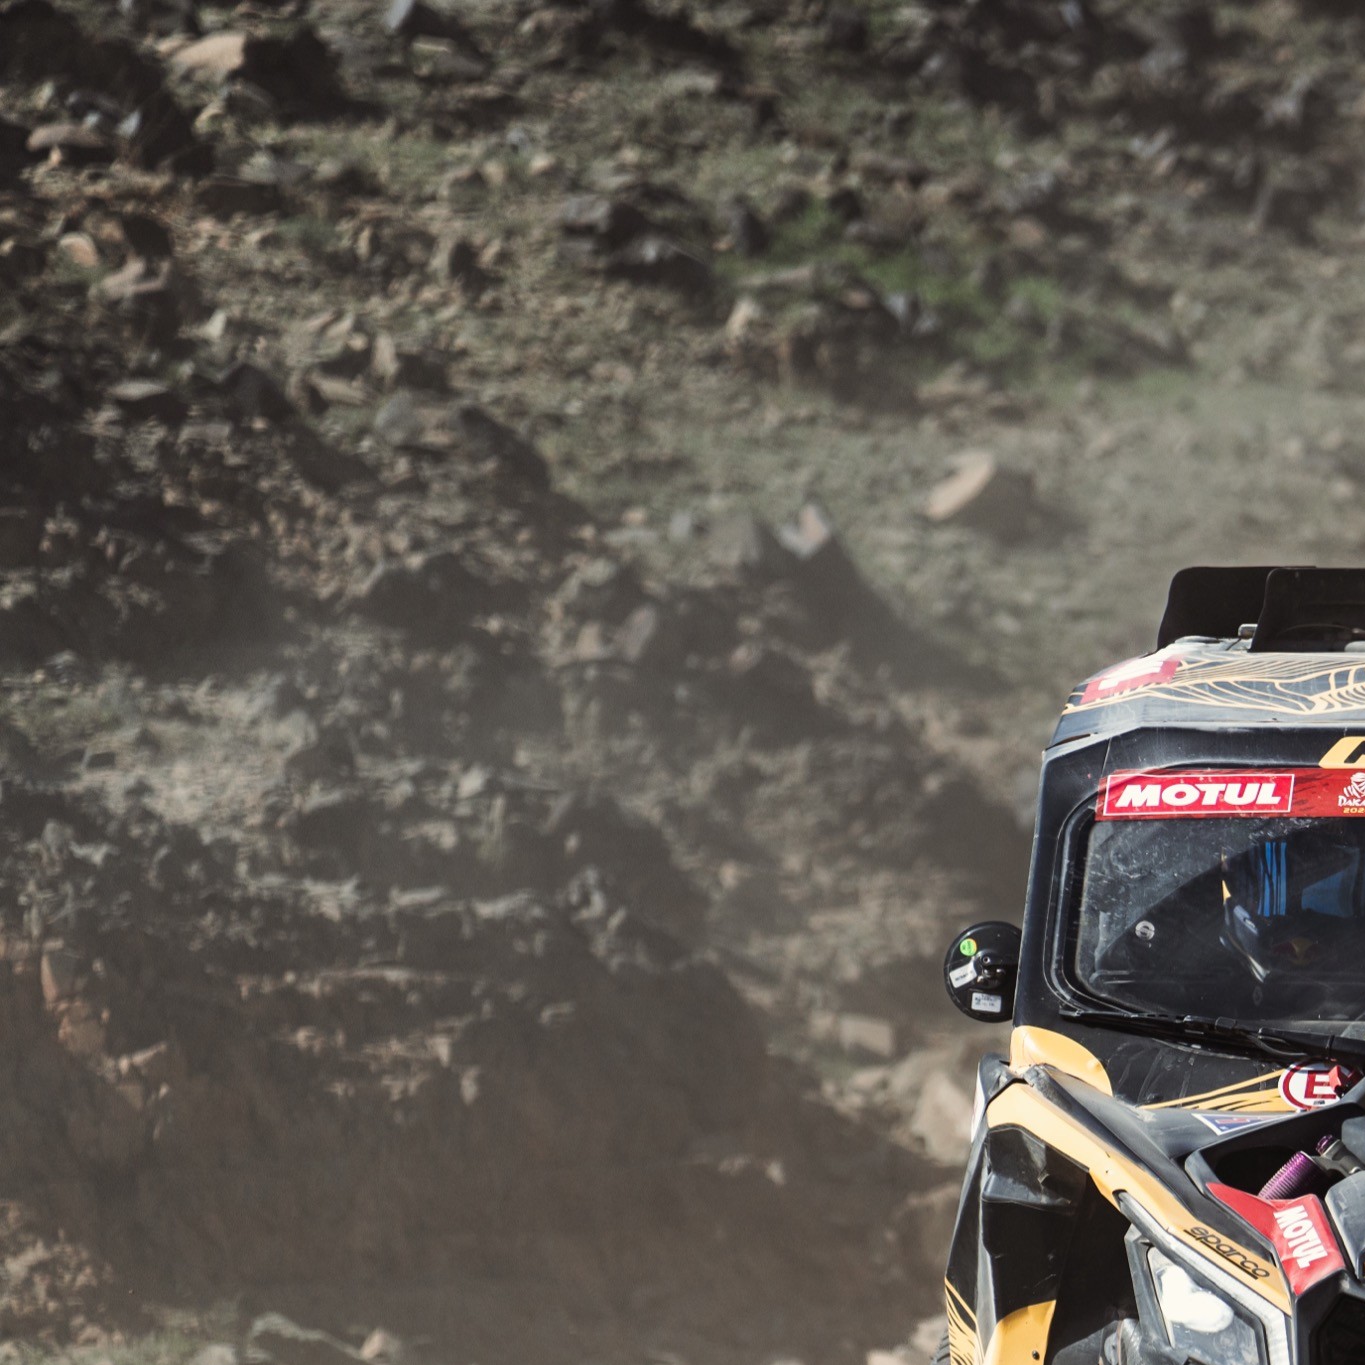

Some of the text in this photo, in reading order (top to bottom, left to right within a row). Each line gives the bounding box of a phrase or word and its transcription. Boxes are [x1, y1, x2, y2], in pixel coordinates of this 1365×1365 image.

[1115, 783, 1281, 808] MOTUL
[1190, 1226, 1271, 1279] sparco
[1273, 1205, 1329, 1269] MOTUL
